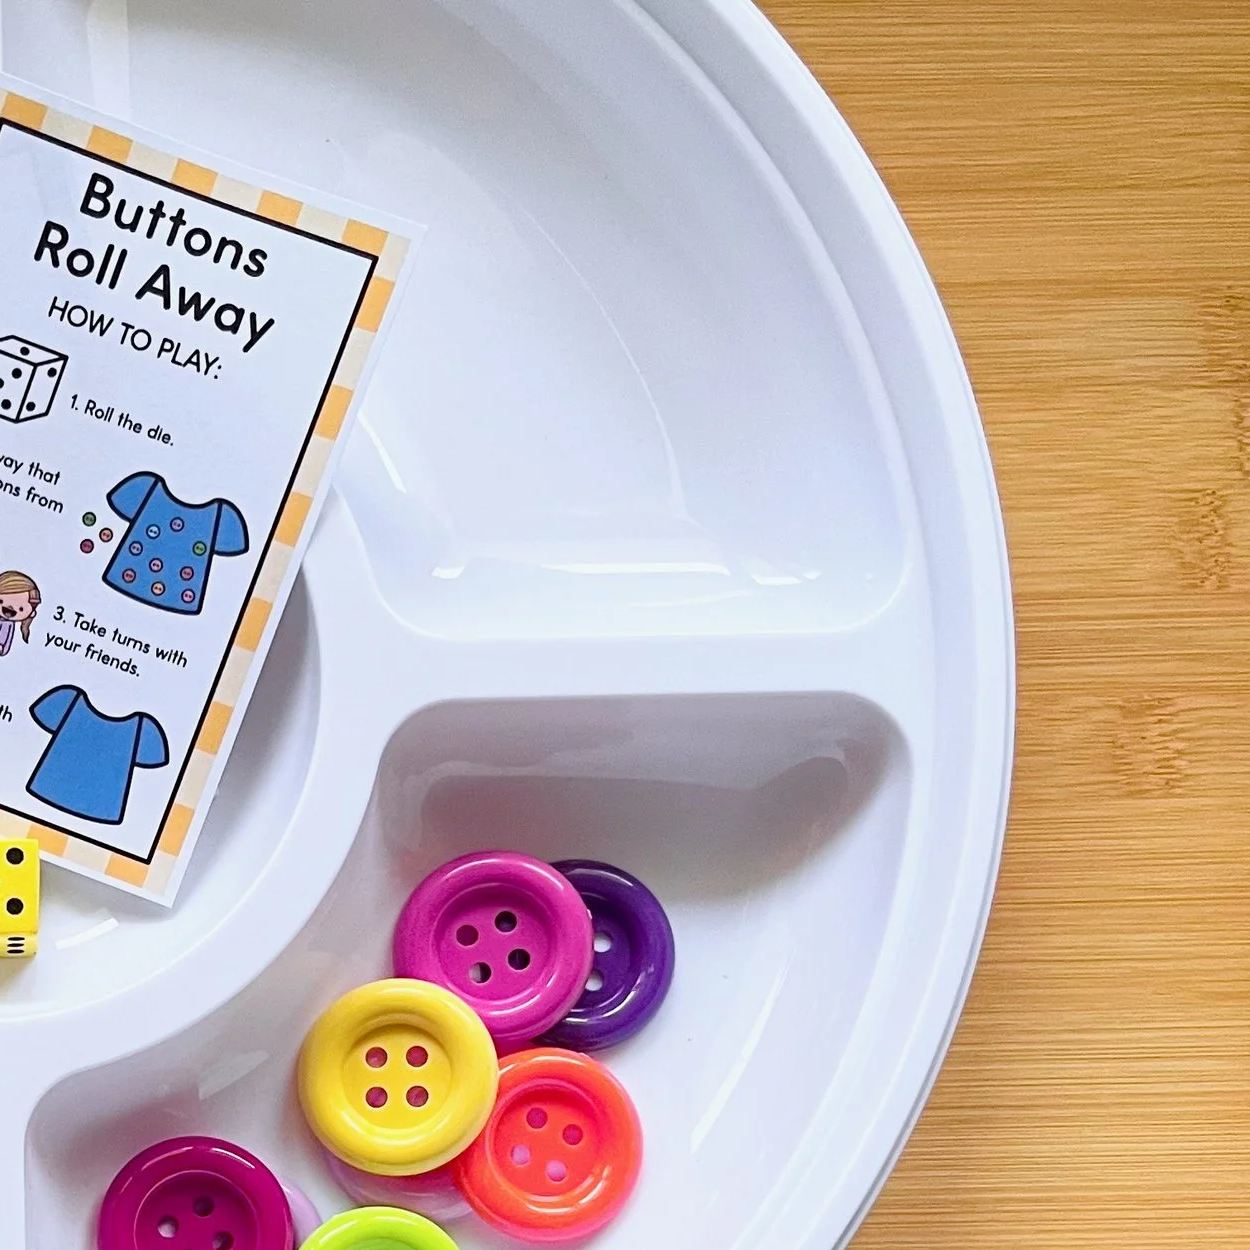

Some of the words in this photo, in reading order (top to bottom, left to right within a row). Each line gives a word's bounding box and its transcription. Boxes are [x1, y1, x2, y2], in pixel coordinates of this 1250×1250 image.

[79, 172, 268, 278] Buttons
[33, 220, 128, 290] Roll
[134, 263, 275, 354] Away
[47, 295, 115, 338] HOW
[120, 321, 152, 352] TO
[156, 337, 222, 380] PLAY:
[70, 393, 79, 411] 1.
[83, 398, 115, 423] Roll
[117, 412, 143, 434] the
[147, 424, 174, 447] die.
[25, 486, 64, 514] from
[27, 461, 61, 486] that
[44, 632, 82, 653] your
[84, 643, 140, 677] friends.
[53, 605, 66, 624] 3.
[73, 611, 107, 638] Take
[111, 627, 151, 654] turns
[155, 647, 188, 668] with
